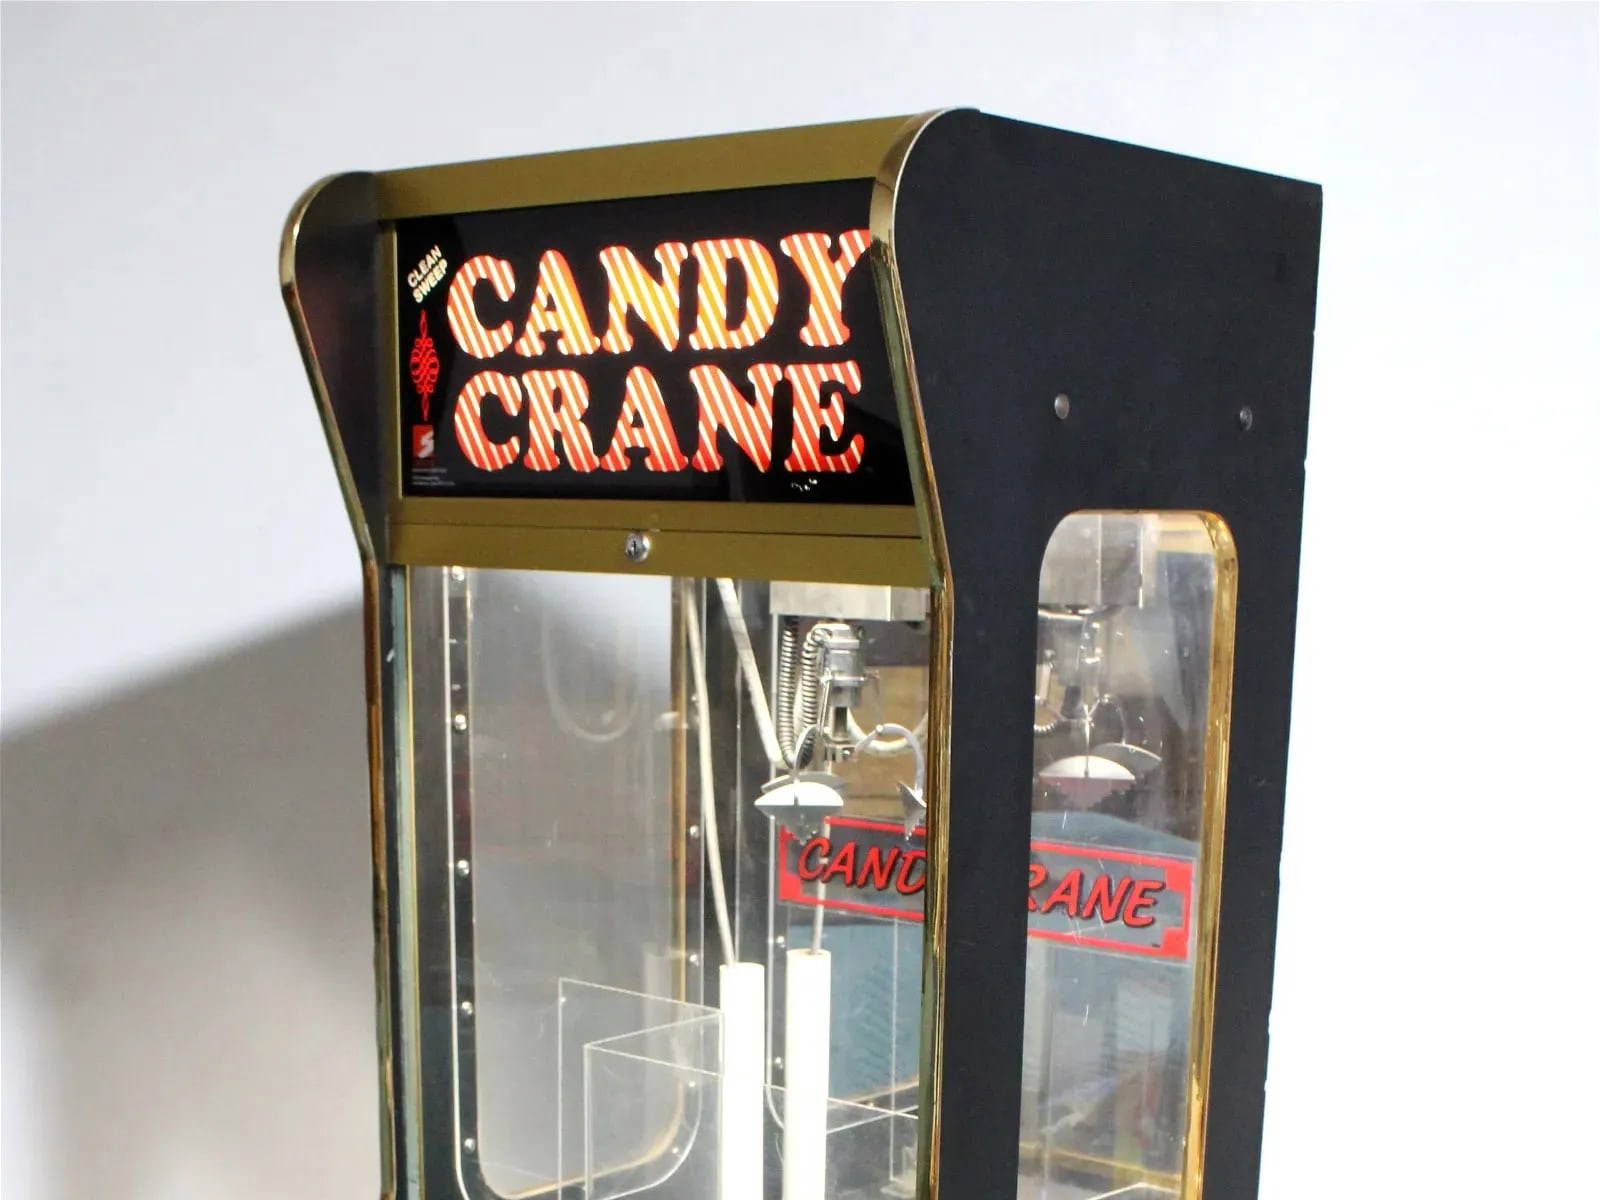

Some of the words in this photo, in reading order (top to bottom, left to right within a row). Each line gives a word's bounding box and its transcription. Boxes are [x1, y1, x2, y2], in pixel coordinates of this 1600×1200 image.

[407, 245, 443, 288] CLEAN
[413, 259, 449, 304] SWEEP
[446, 228, 871, 359] CANDY
[454, 360, 865, 473] CRANE
[798, 836, 927, 895] CAND
